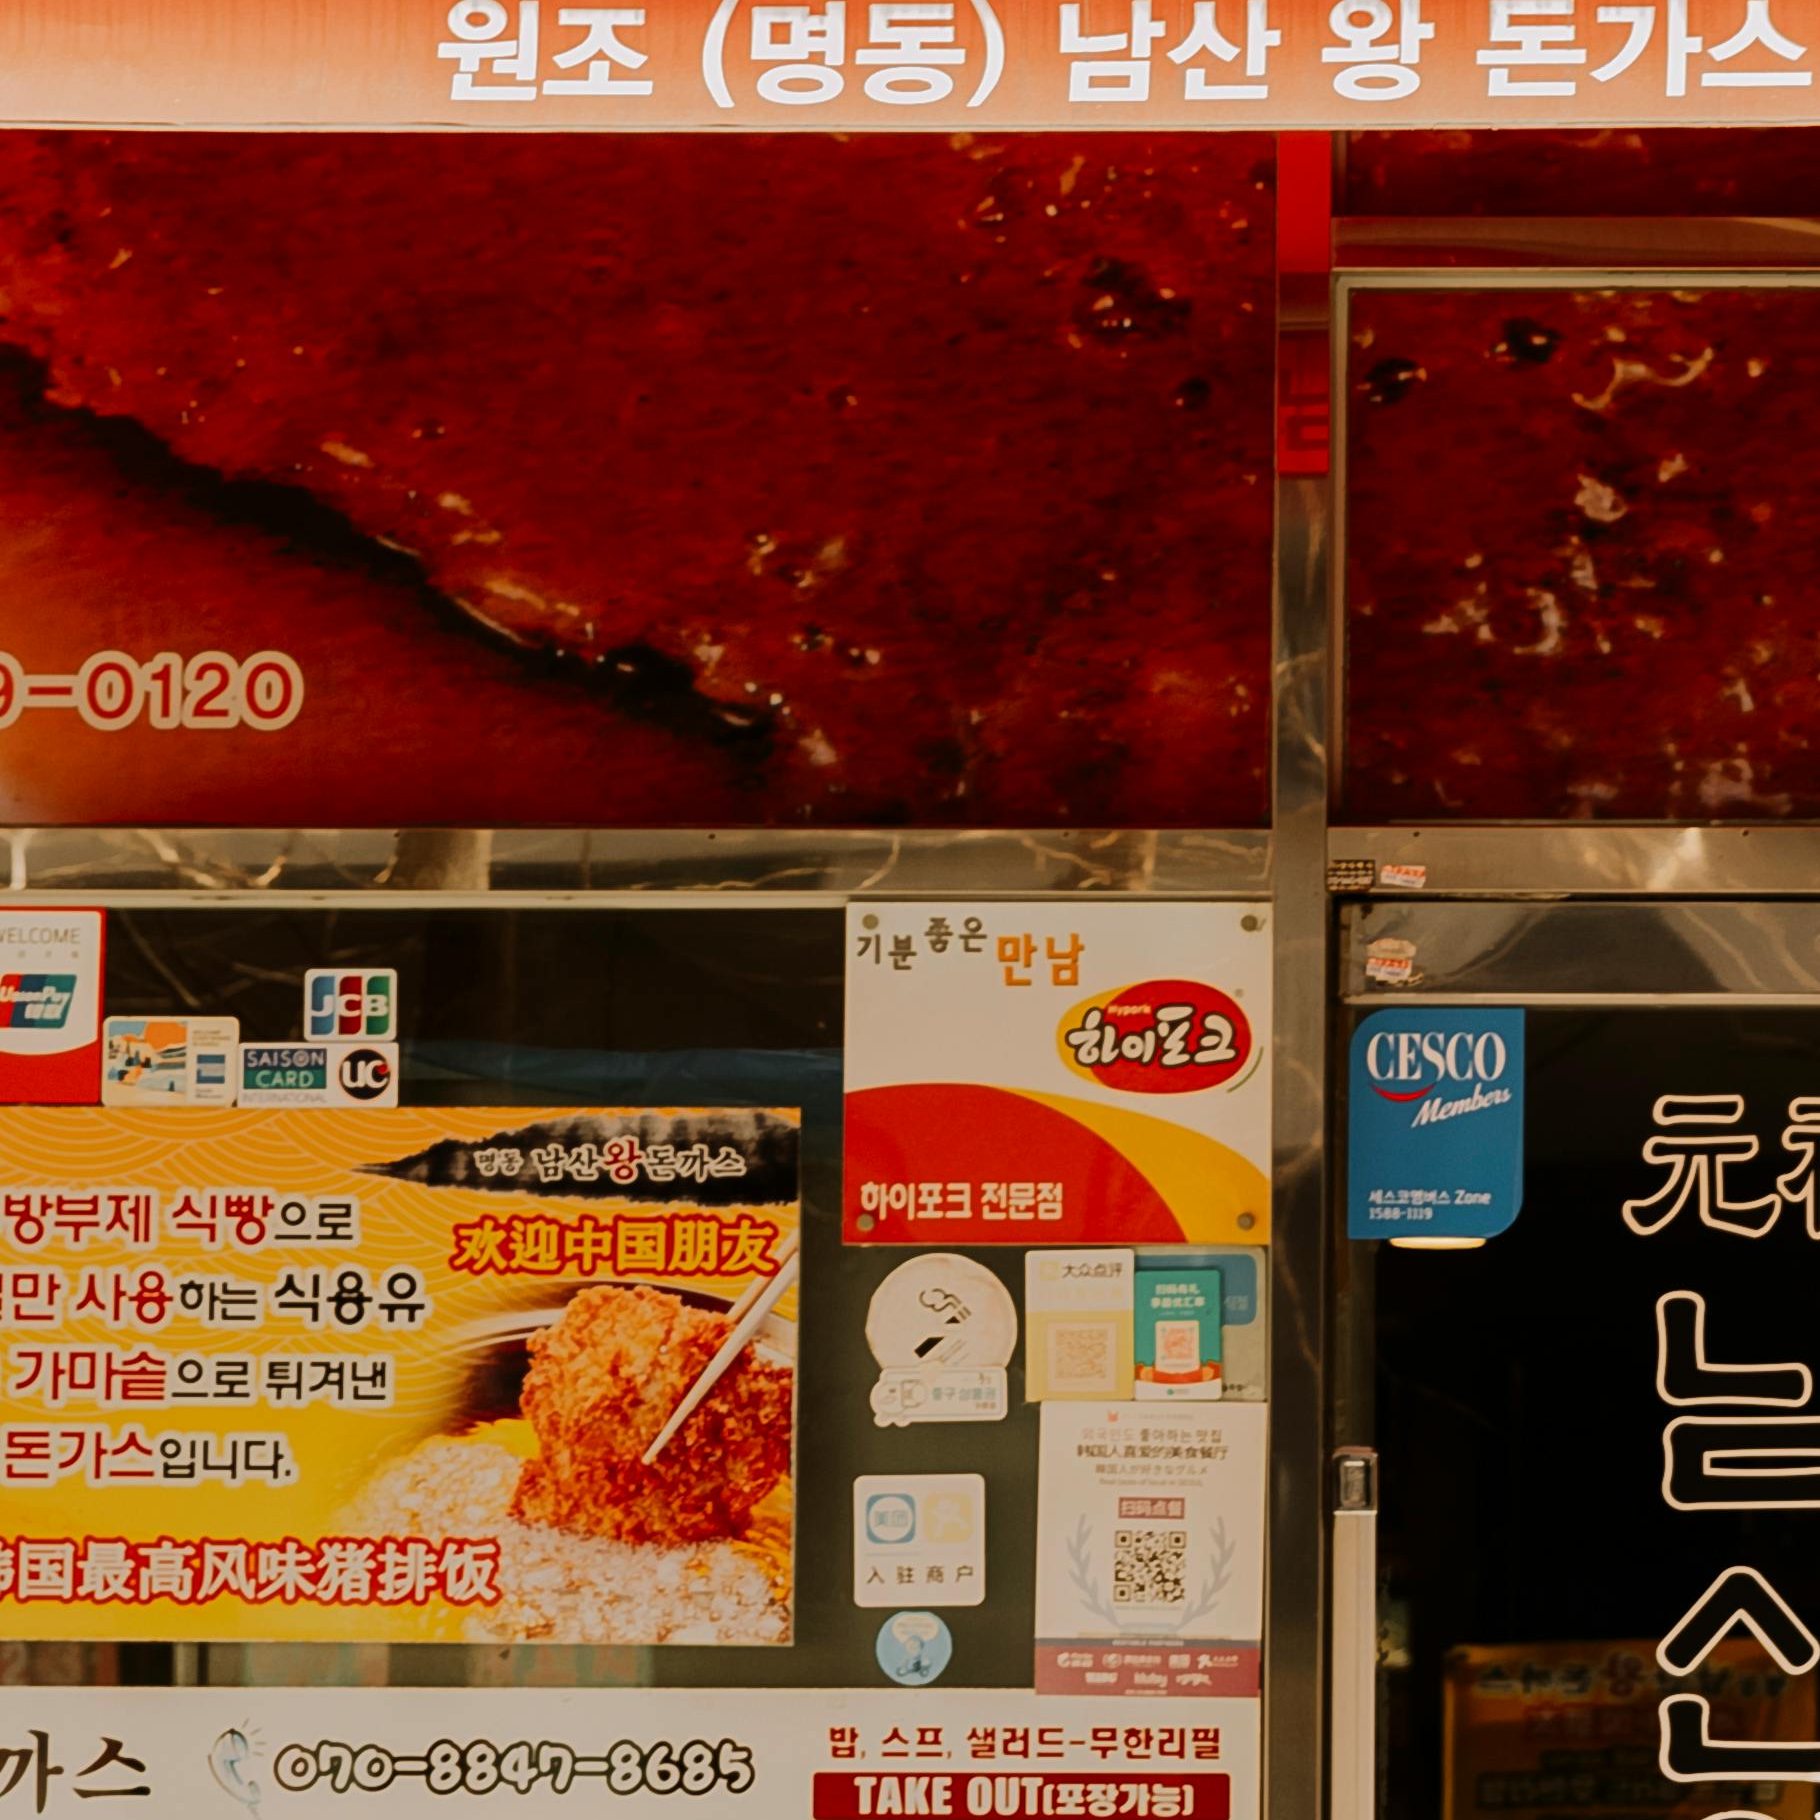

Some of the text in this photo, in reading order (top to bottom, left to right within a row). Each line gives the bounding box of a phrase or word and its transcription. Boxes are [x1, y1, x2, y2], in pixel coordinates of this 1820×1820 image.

[856, 935, 918, 970] 기분
[997, 933, 1086, 987] 만남
[311, 995, 389, 1017] JCB
[246, 1050, 326, 1068] SAISON
[255, 1069, 315, 1088] CARD
[1366, 1032, 1507, 1081] CESCO
[1411, 1082, 1513, 1129] Members
[3, 1192, 355, 1246] 방부제 식빵으로
[860, 1181, 1065, 1221] 하이포크 전문점
[452, 1217, 777, 1274] 欢迎中国朋友
[75, 1270, 426, 1326] 사용하는 식용유
[14, 1350, 388, 1401] 가마솥으로 튀겨낸
[4, 1430, 293, 1480] 돈가스입니다.
[274, 1739, 756, 1794] 070-8847-8685
[853, 1776, 953, 1817] TAKE
